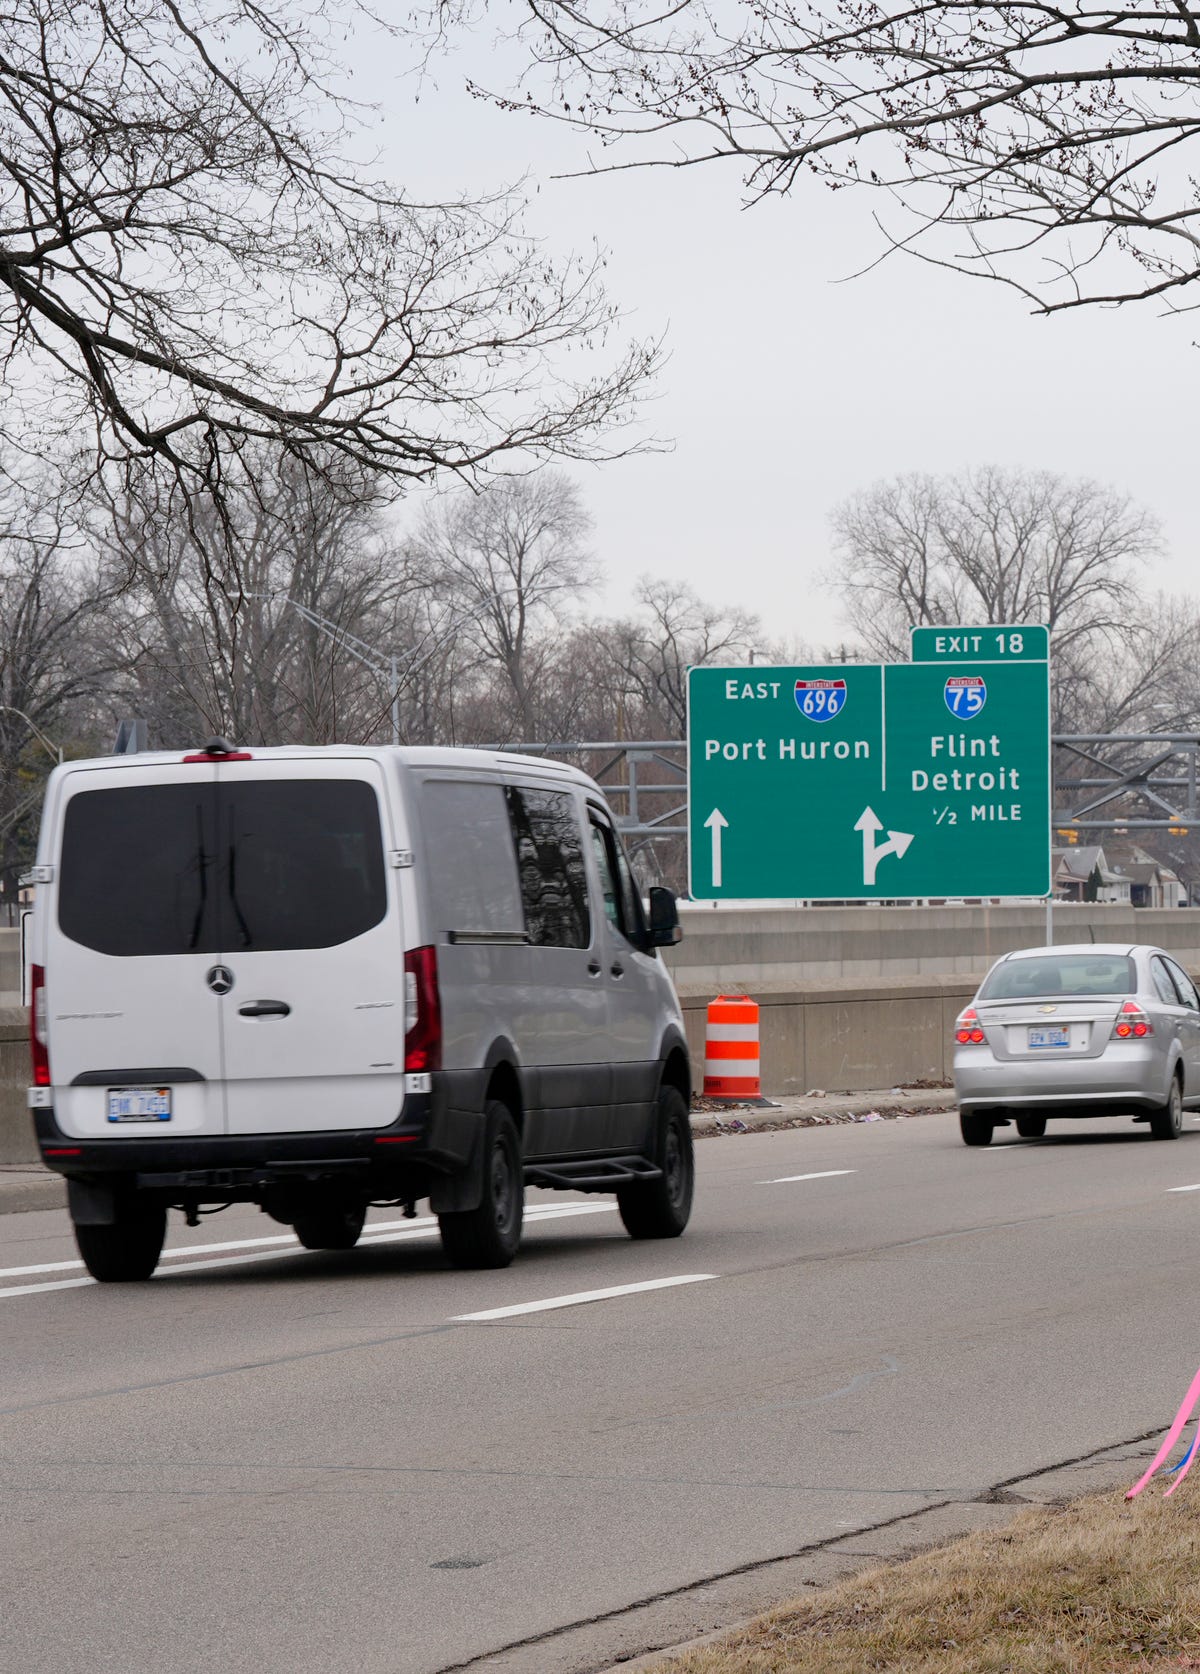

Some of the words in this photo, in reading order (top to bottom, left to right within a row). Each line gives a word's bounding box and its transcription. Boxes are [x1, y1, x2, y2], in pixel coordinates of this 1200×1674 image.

[935, 636, 982, 653] EXIT
[995, 633, 1024, 654] 18
[725, 679, 781, 700] EAST
[948, 687, 983, 711] 75
[803, 690, 838, 714] 696
[705, 739, 766, 761] Port
[779, 738, 870, 760] Huron
[931, 734, 1001, 758] Flint
[911, 767, 1020, 791] Detroit
[971, 804, 1022, 821] MILE
